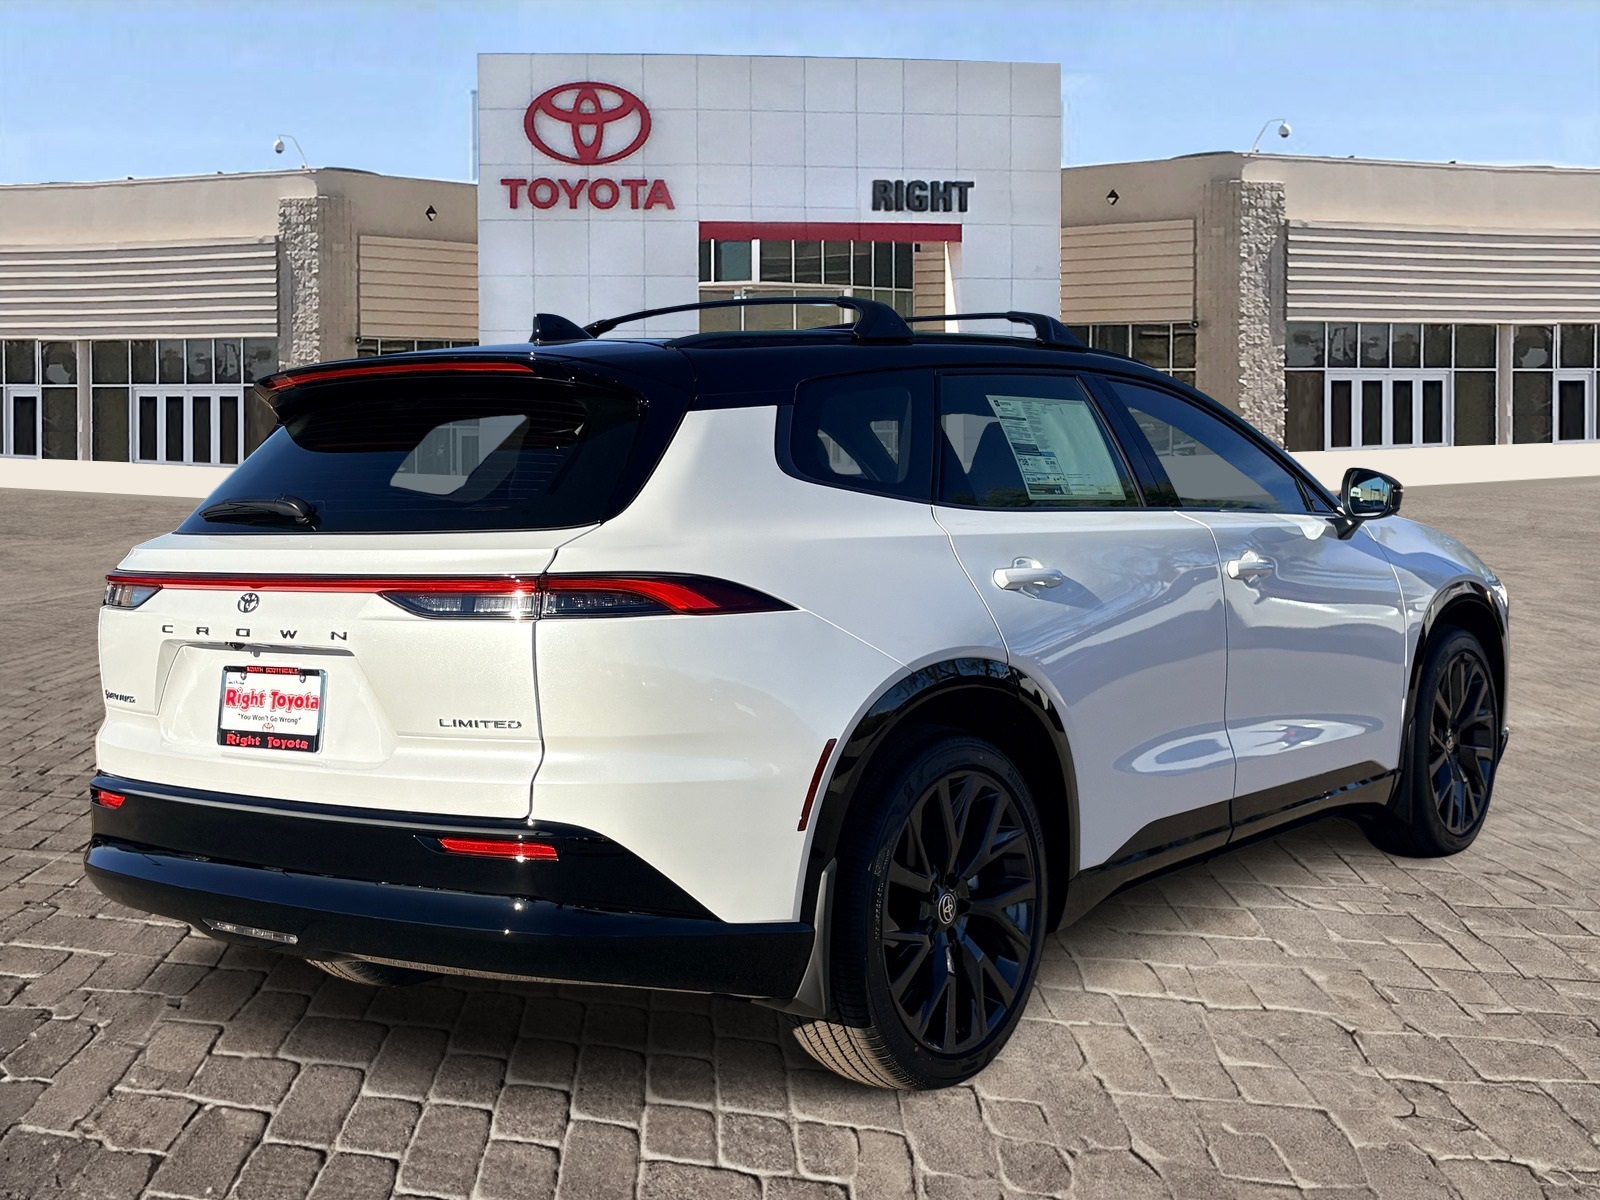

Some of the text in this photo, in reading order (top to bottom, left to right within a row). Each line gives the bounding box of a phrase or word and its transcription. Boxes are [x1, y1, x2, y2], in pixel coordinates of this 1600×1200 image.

[501, 178, 675, 210] TOYOTA
[872, 180, 975, 213] RIGHT
[162, 625, 347, 641] CROWN
[225, 688, 319, 711] Right Toyota
[439, 718, 522, 729] LIMITED
[226, 734, 308, 749] Right Toyota
